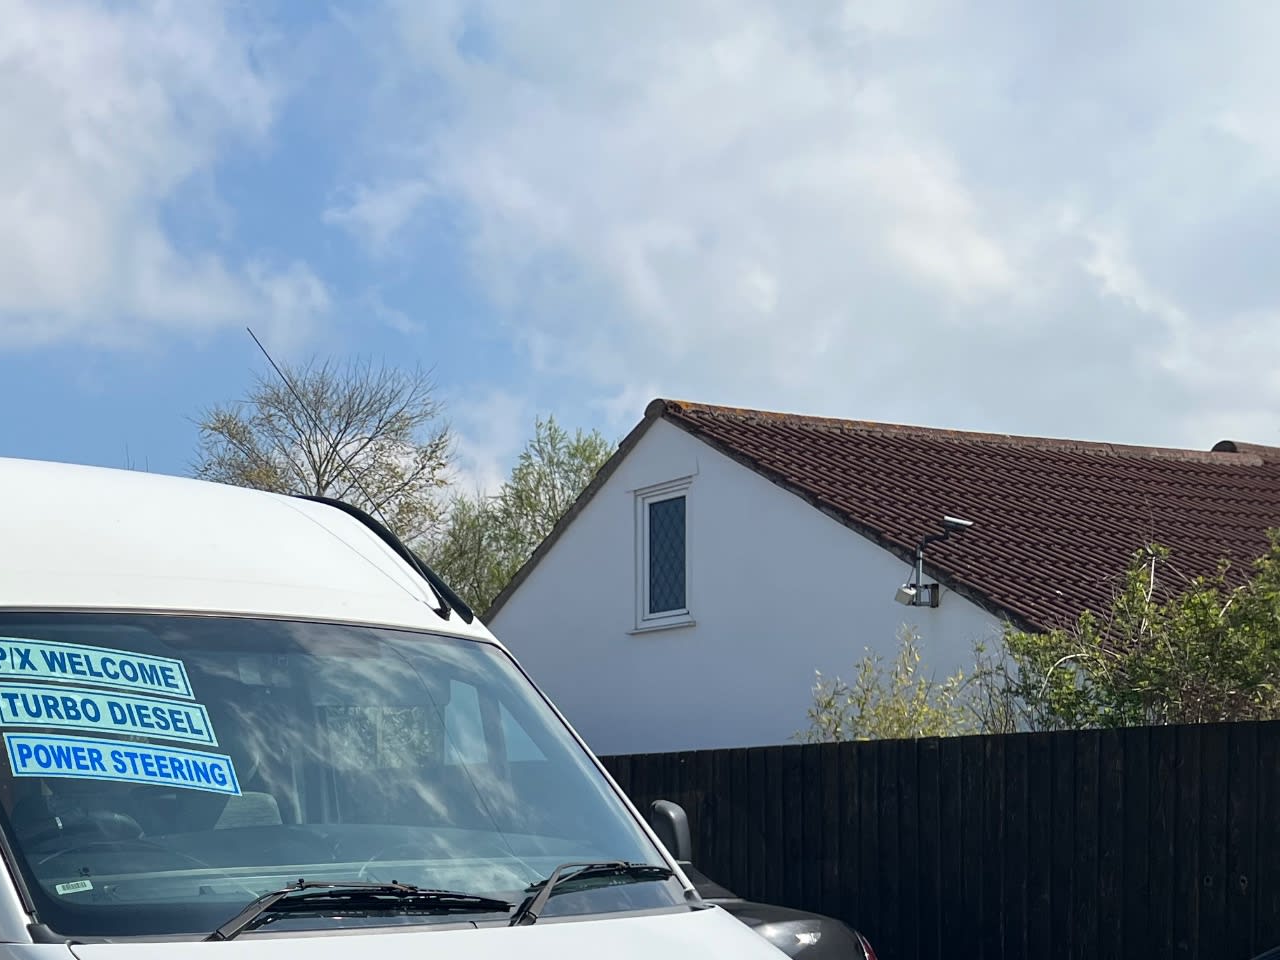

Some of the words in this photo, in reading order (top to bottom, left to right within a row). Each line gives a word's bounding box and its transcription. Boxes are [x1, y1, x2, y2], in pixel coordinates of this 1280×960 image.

[40, 650, 180, 690] WELCOME
[1, 692, 101, 723] TURBO
[108, 700, 204, 736] DIESEL
[16, 744, 107, 773] POWER
[110, 751, 228, 787] STEERING
